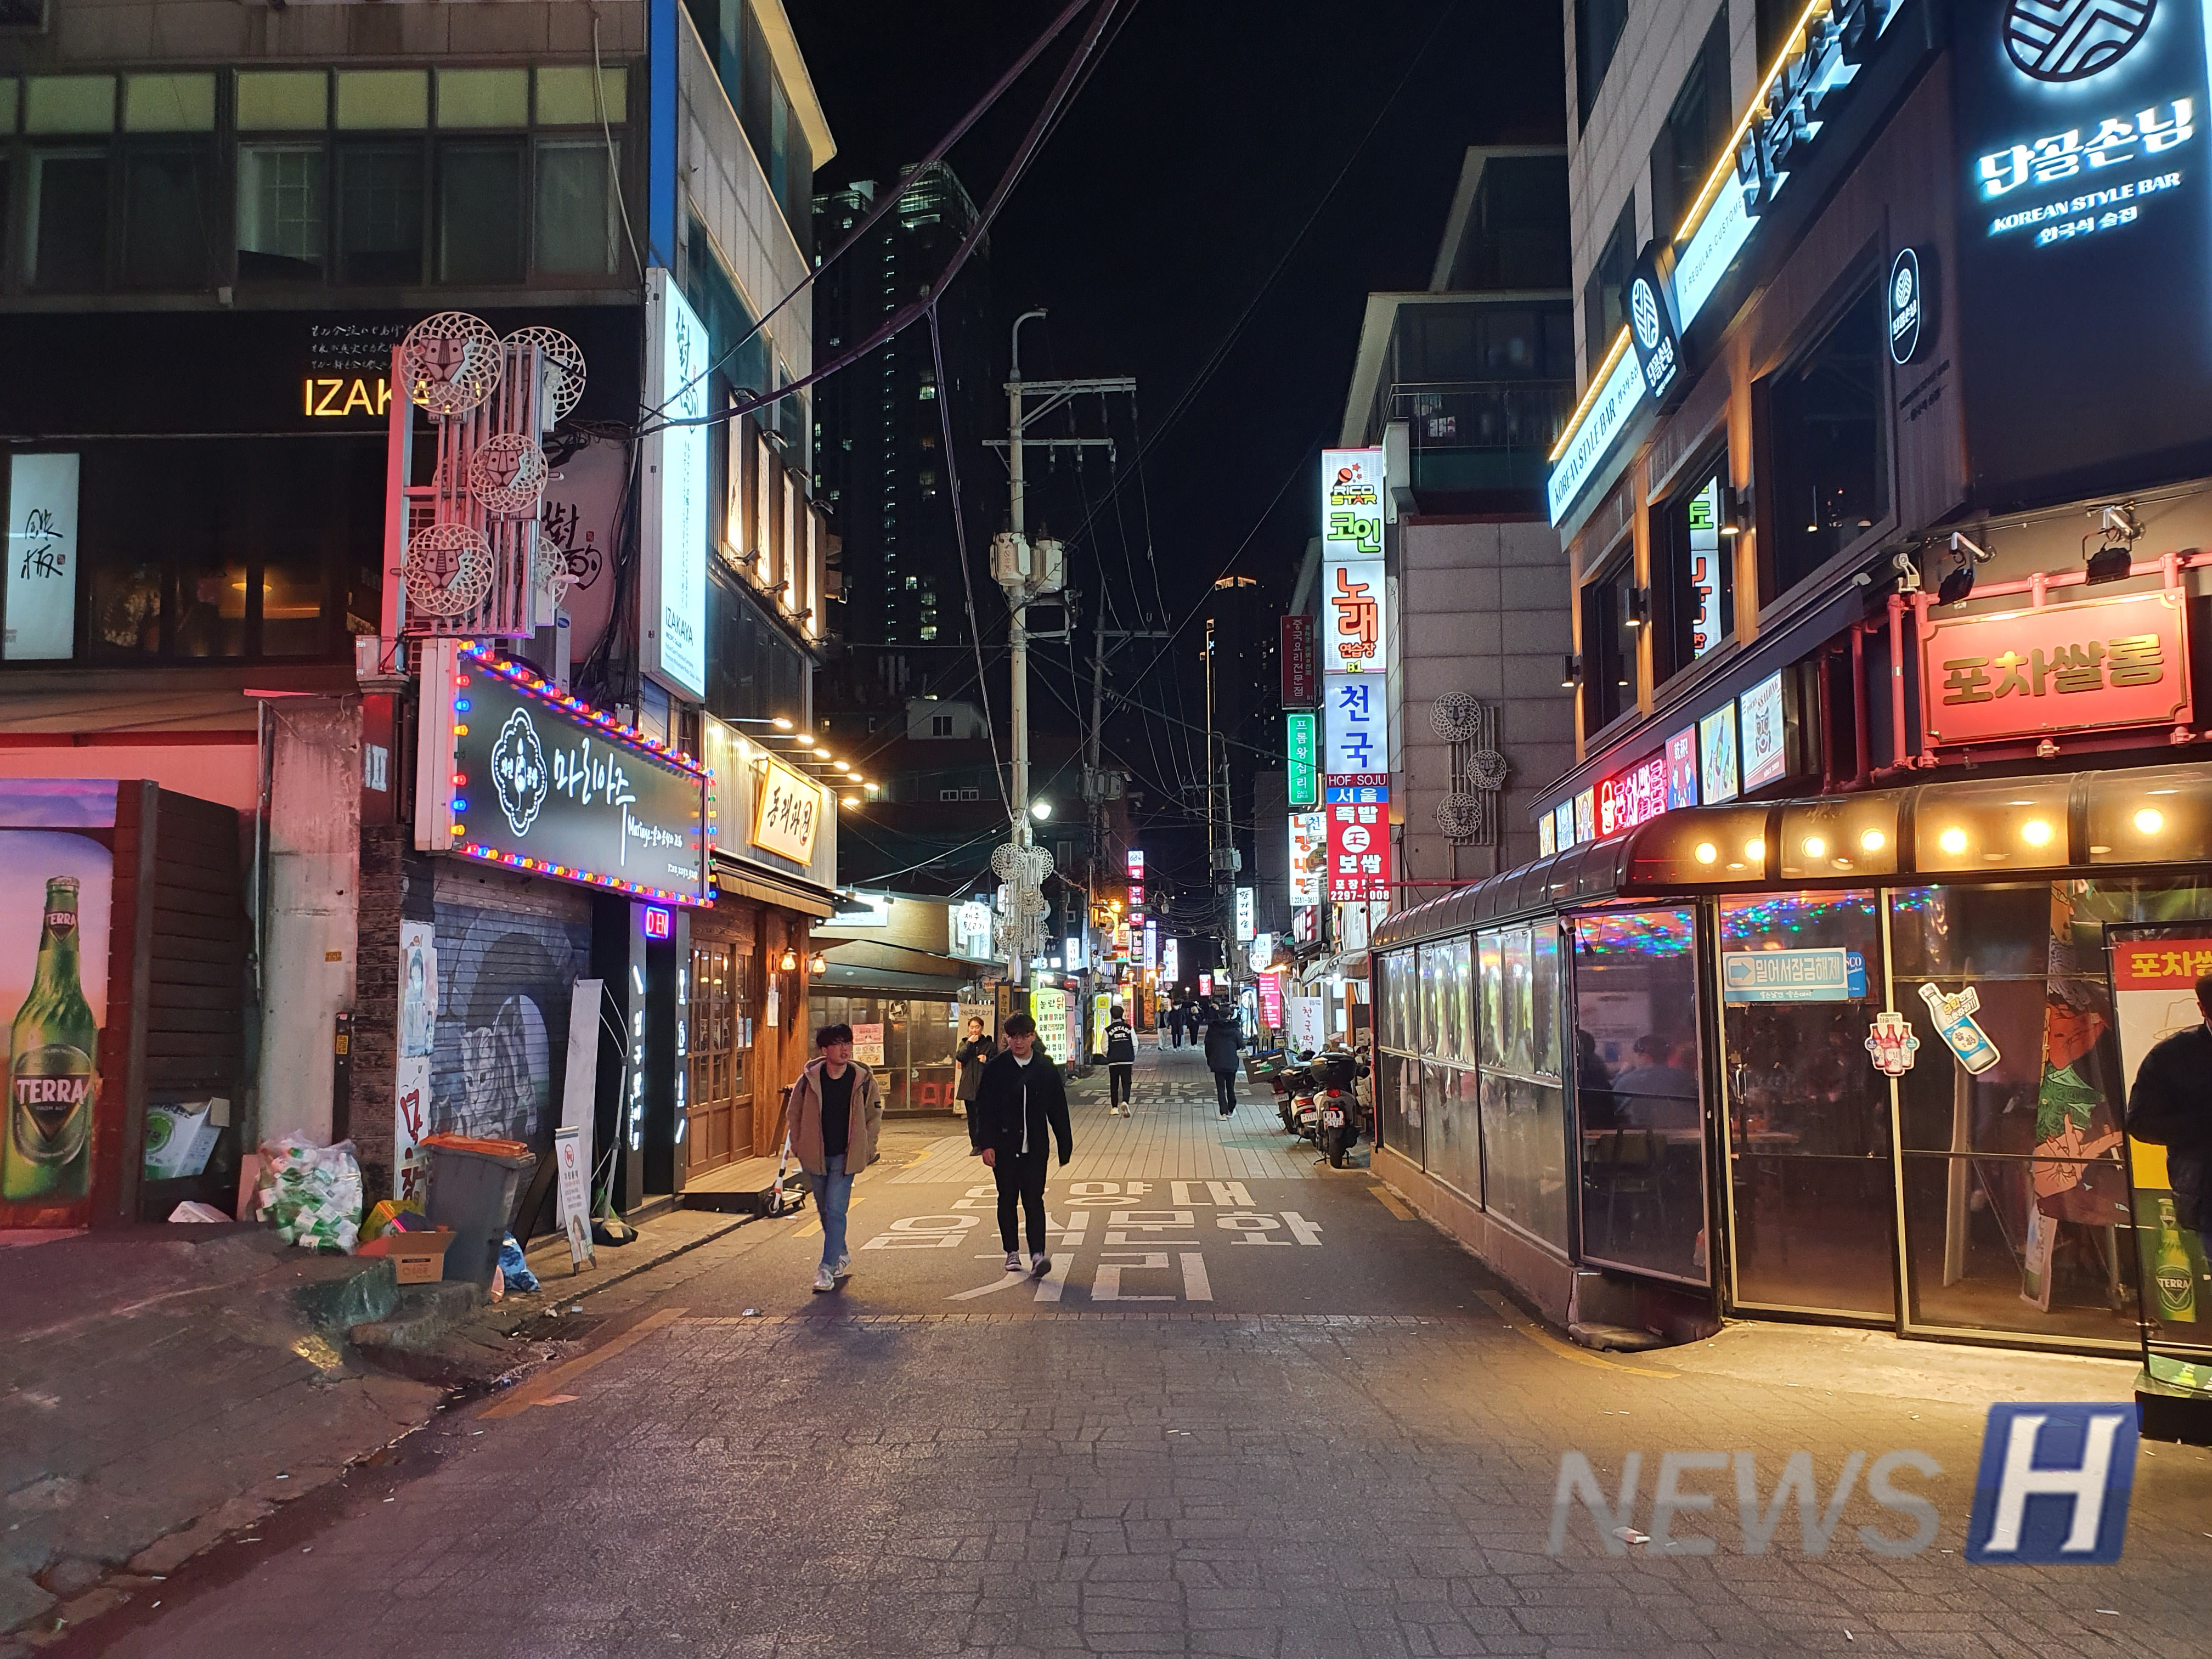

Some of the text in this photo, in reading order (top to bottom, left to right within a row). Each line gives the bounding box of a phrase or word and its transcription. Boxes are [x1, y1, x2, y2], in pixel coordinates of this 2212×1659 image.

[1978, 97, 2194, 198] 단골손님
[1991, 172, 2181, 235] KOREAN STYLE BAR
[2038, 206, 2138, 245] 한국식 술집
[1688, 244, 1713, 286] REGULAR
[1554, 464, 1579, 507] KOREAN
[1578, 420, 1600, 470] STYLE
[1599, 398, 1616, 437] BAR
[1331, 494, 1377, 505] STAR
[1334, 484, 1374, 495] RICO
[1328, 512, 1381, 553] 코인
[1332, 568, 1378, 642] 노래
[665, 606, 693, 647] IZAKAYA
[1292, 619, 1304, 697] 중국요리전문점
[1339, 642, 1376, 658] 연습장
[1347, 660, 1363, 673] B1
[1943, 633, 2164, 706] 포차쌀롱
[1338, 685, 1373, 768] 천국
[1296, 720, 1308, 789] 프롬왕십리
[1328, 775, 1386, 786] HOF SOJU
[1336, 788, 1378, 804] 서울
[1335, 805, 1379, 824] 족발
[1338, 854, 1383, 874] 보쌈
[46, 912, 77, 927] TERRA
[1756, 956, 1841, 983] 밀어서잠금해제
[16, 1079, 84, 1105] TERRA
[2158, 1278, 2190, 1290] TERRA
